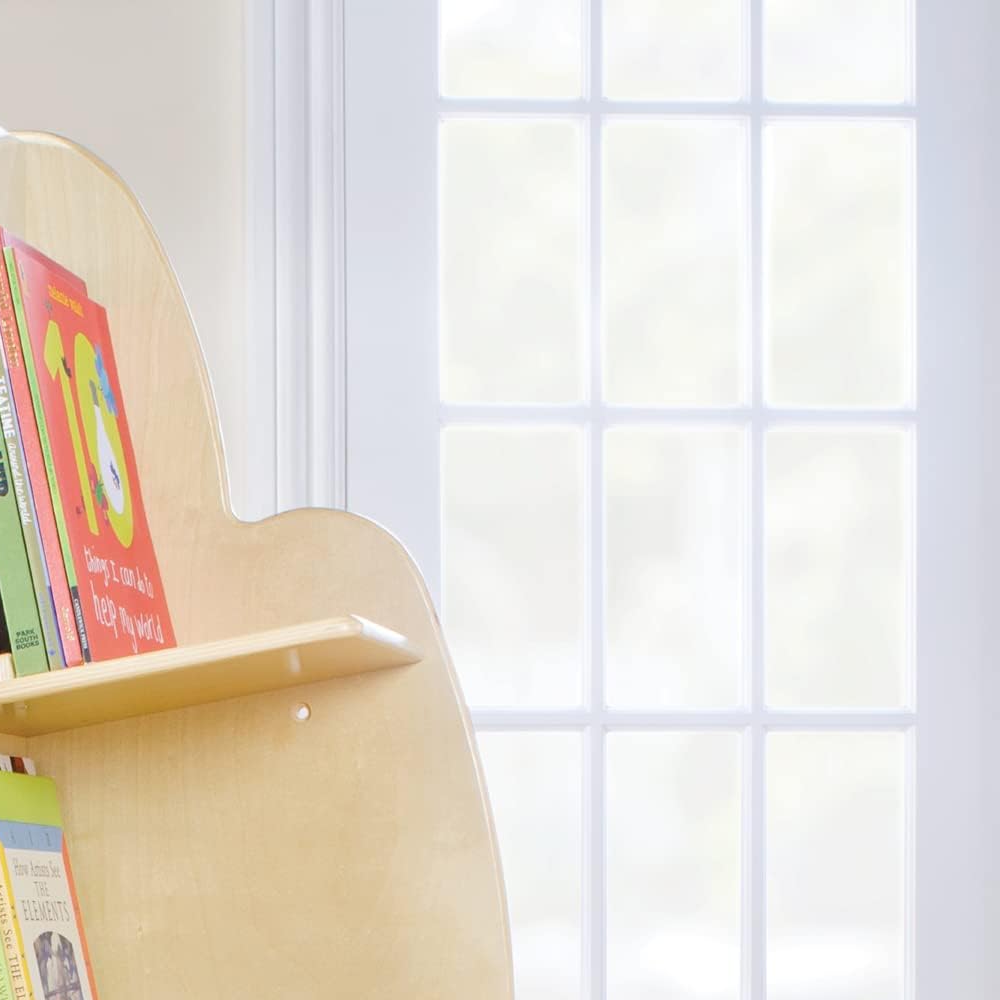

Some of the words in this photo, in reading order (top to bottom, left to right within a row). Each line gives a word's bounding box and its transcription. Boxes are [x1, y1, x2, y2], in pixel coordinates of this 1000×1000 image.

[14, 477, 26, 495] the
[110, 560, 120, 583] I
[120, 567, 136, 589] can
[90, 580, 118, 639] help
[118, 607, 138, 654] my
[134, 613, 164, 644] world
[15, 634, 39, 644] SOUTH
[16, 628, 35, 637] PARK
[16, 640, 40, 650] BOOKS
[34, 881, 50, 897] THE
[21, 900, 70, 922] ELEMENTS
[2, 929, 15, 949] See
[7, 955, 22, 981] THE
